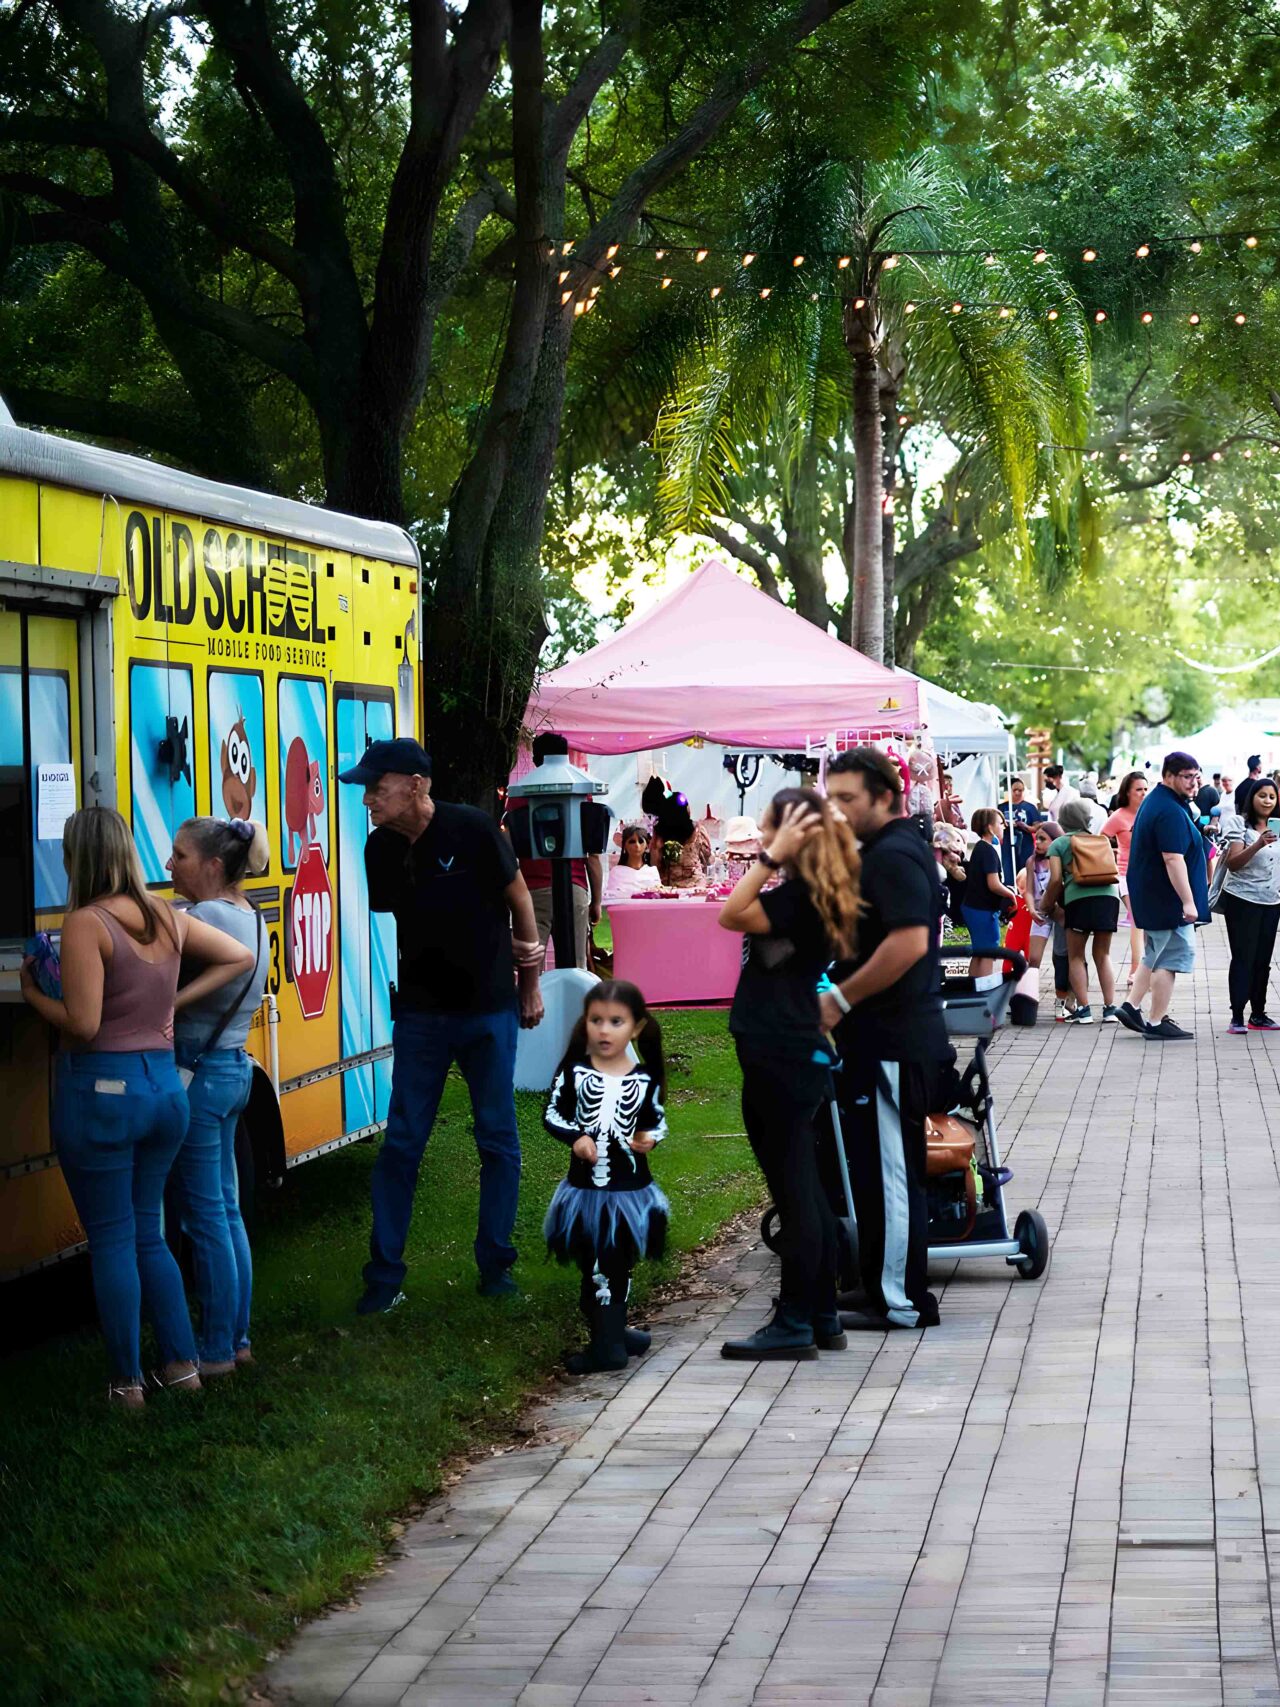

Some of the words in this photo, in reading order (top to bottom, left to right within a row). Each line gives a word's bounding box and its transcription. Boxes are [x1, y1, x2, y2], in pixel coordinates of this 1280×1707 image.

[125, 510, 197, 626] OLD
[207, 637, 250, 659] MOBILE
[255, 642, 282, 663] FOOD
[286, 646, 327, 668] SERVICE
[293, 891, 332, 977] STOP
